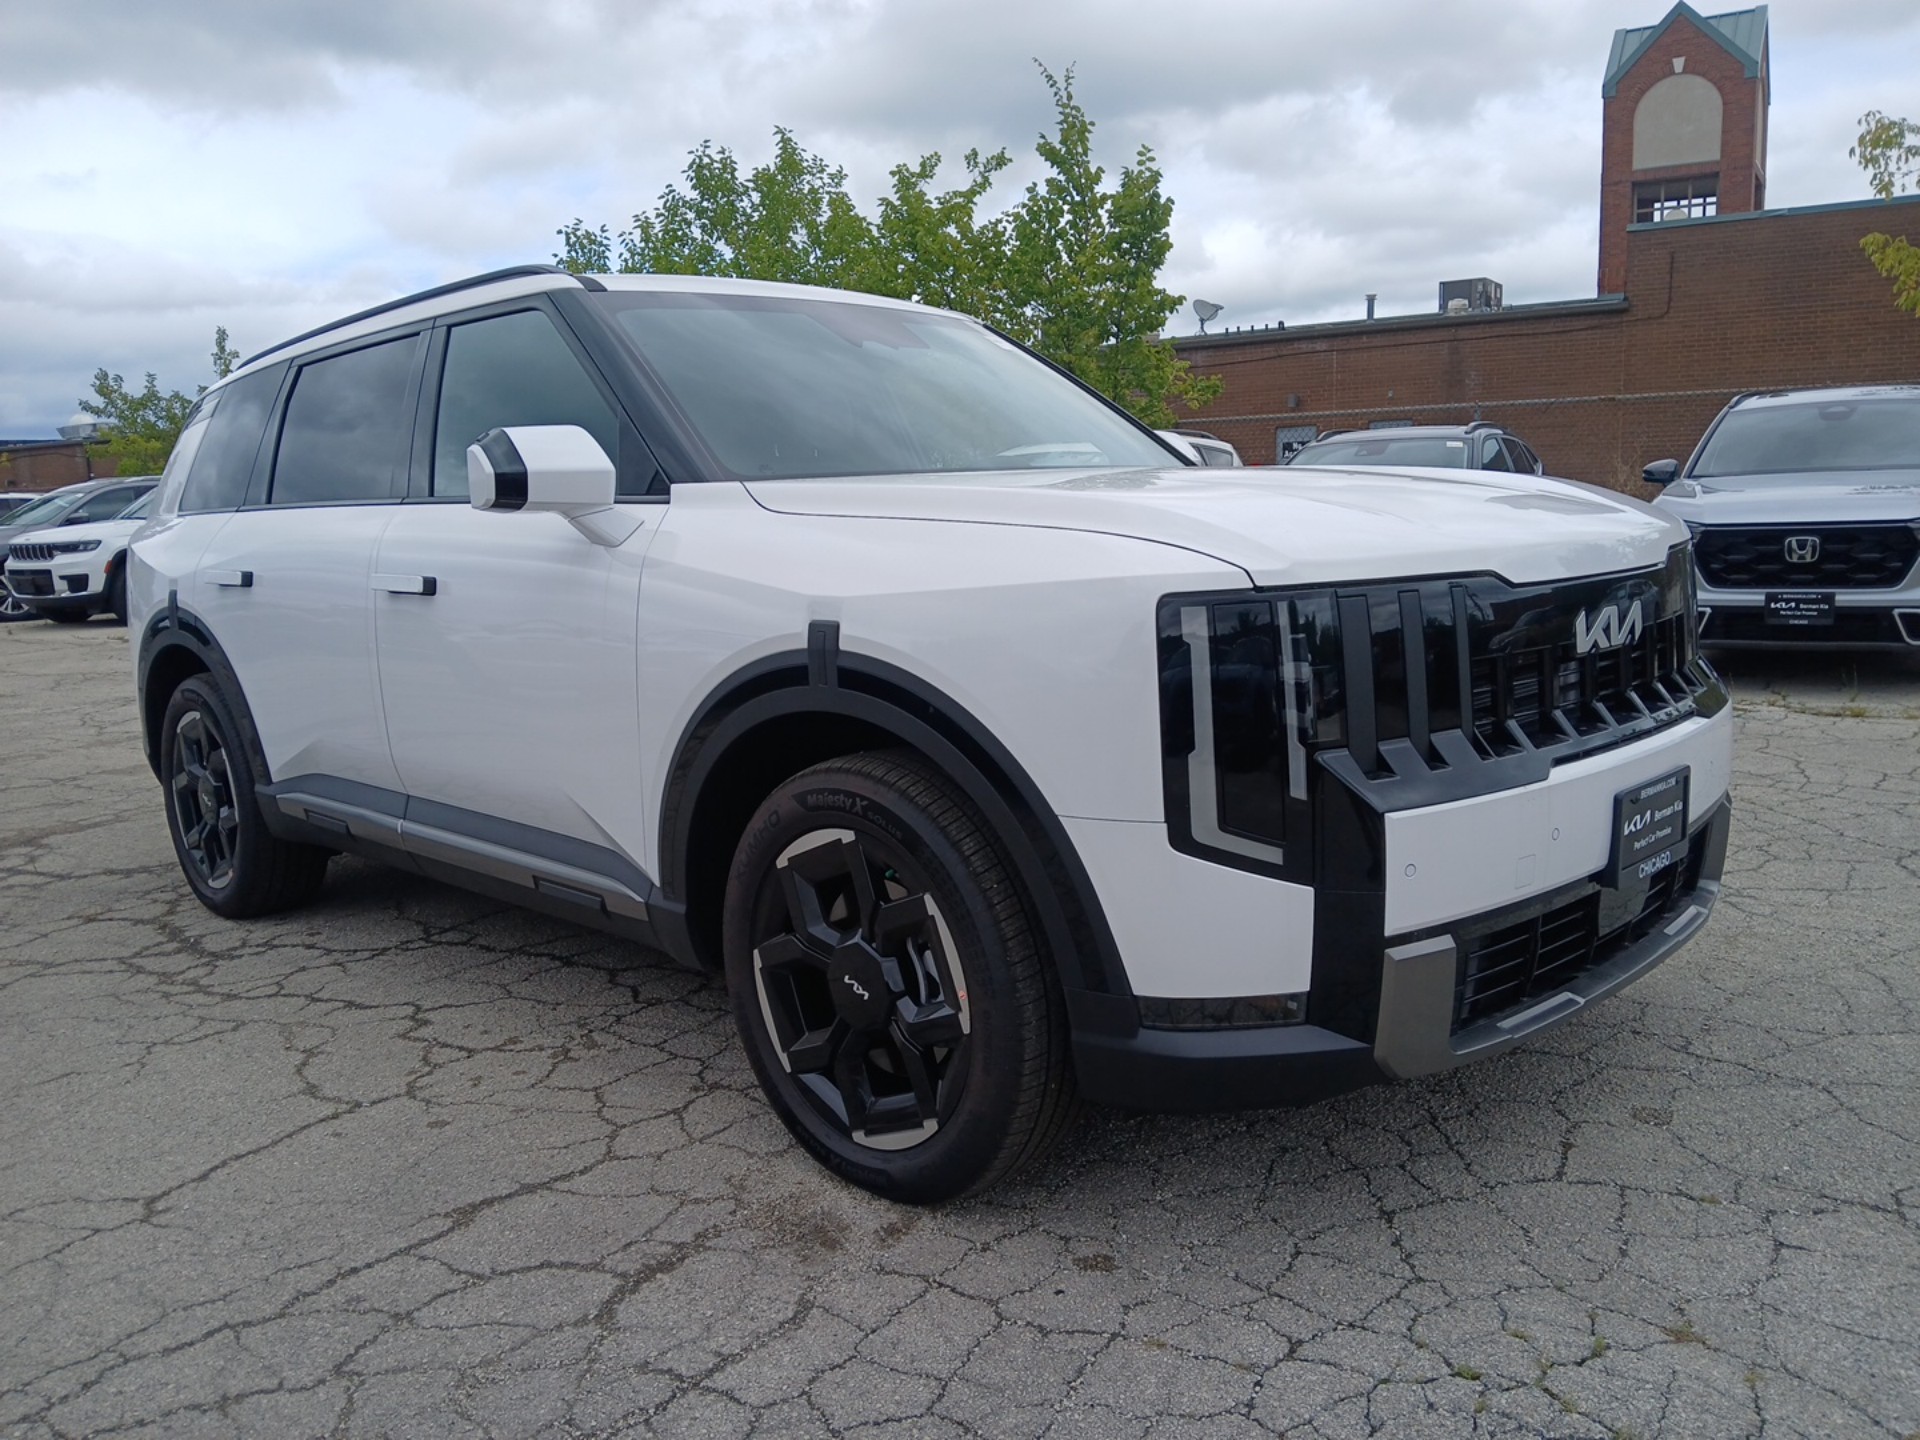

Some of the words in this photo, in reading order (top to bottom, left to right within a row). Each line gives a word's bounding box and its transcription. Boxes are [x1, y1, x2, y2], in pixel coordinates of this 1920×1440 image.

[1576, 600, 1643, 653] KIA
[807, 792, 853, 811] Majesty
[852, 797, 868, 816] X
[1624, 809, 1651, 836] KIA
[1654, 806, 1673, 822] Berman
[1648, 833, 1656, 844] Car
[1638, 850, 1670, 879] CHICAGO
